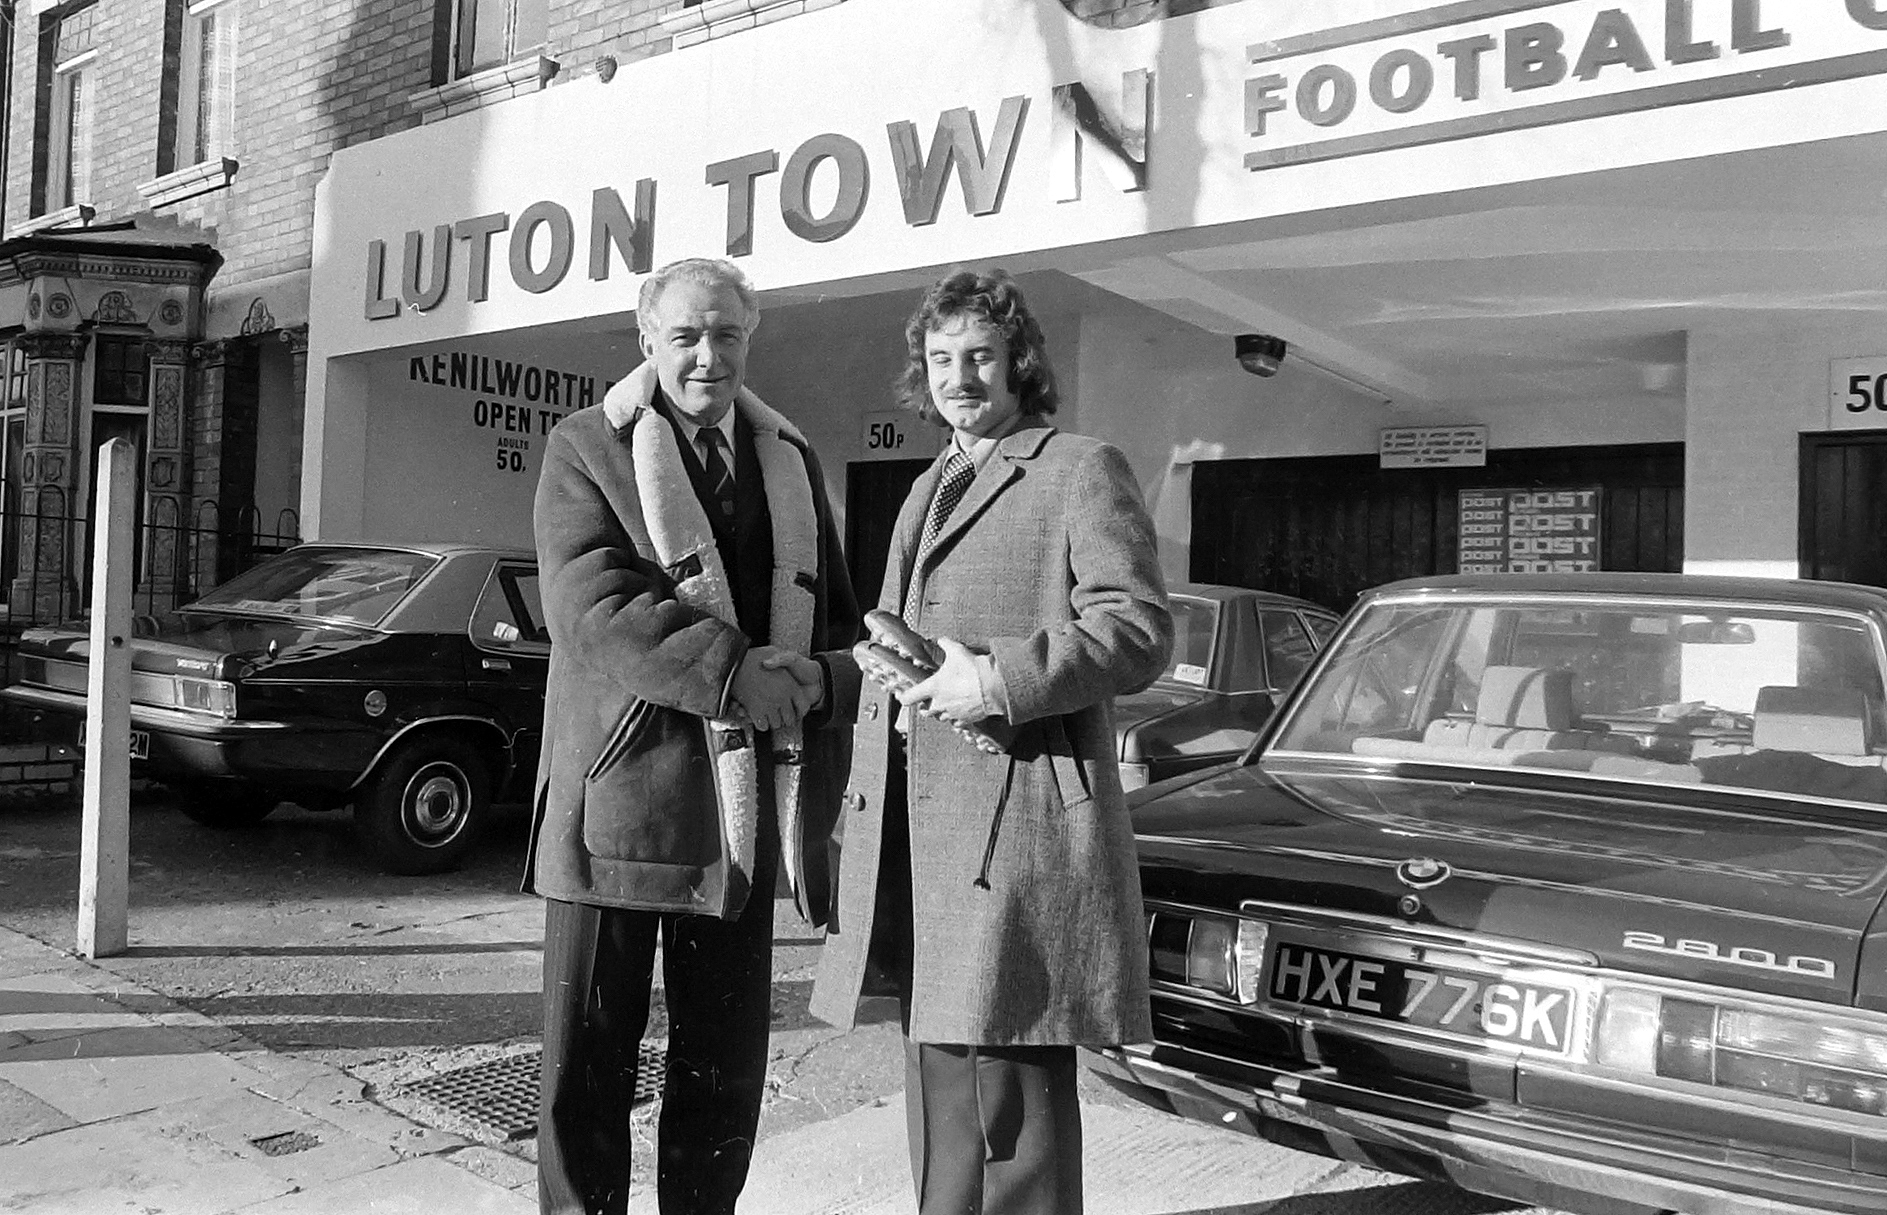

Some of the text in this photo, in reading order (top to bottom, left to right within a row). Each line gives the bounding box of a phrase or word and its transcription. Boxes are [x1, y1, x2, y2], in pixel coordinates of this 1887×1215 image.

[1244, 0, 1792, 138] FOOTBALL
[364, 67, 1156, 321] LUTON TOWN
[410, 352, 595, 409] KENILWORTH
[474, 400, 531, 434] OPEN
[1623, 931, 1835, 979] 2800
[1276, 948, 1564, 1046] HXE 776K
